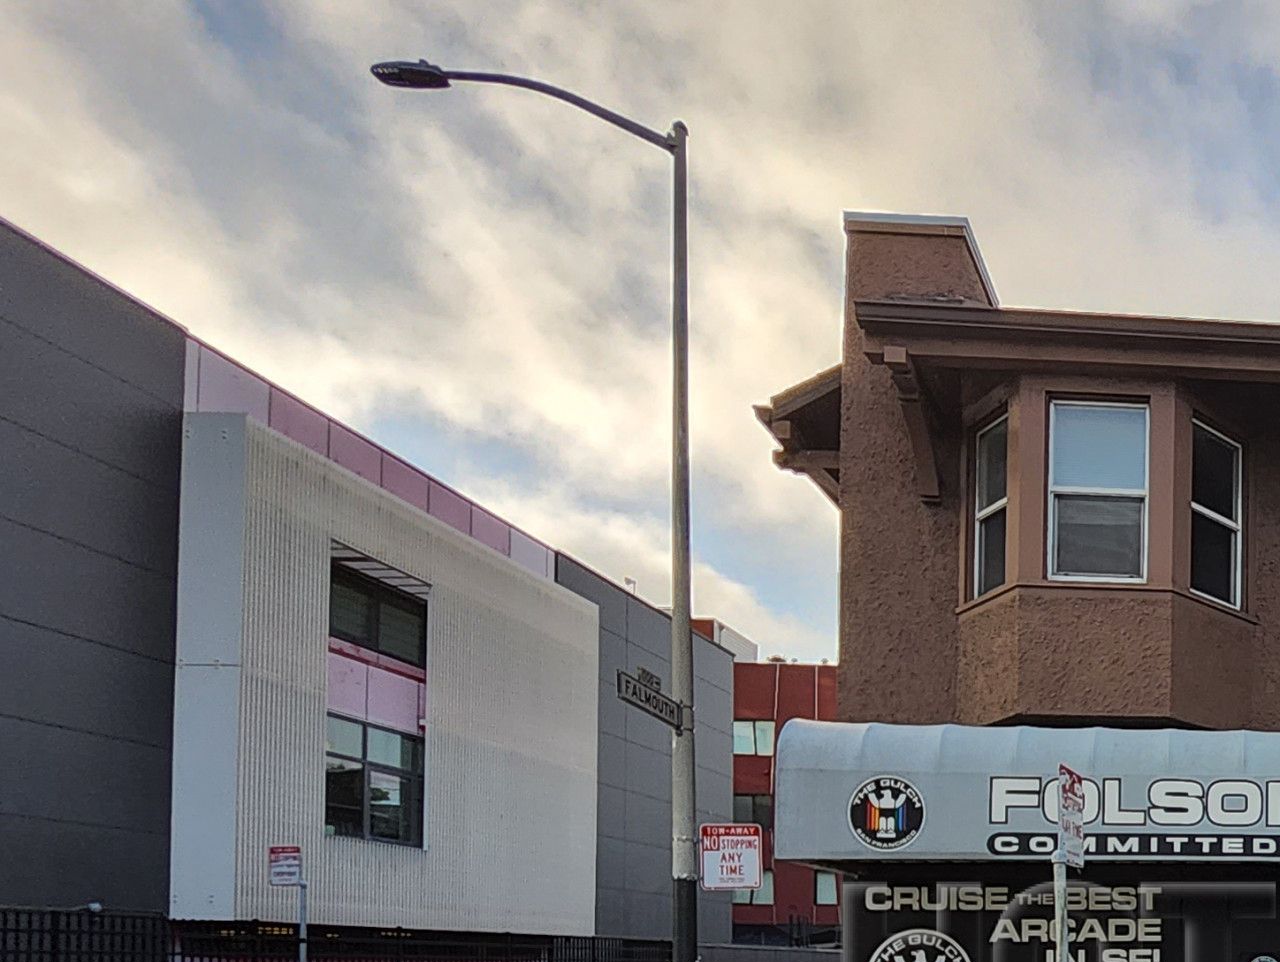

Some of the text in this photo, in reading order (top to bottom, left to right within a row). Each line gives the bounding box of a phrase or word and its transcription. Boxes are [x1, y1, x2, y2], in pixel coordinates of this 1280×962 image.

[625, 679, 675, 720] FALMOUTH
[853, 778, 922, 808] THE GULCH
[707, 827, 755, 835] TOW-AWAY
[856, 828, 872, 844] SAN
[703, 836, 758, 850] NO STOPPING
[993, 836, 1278, 854] COMITTED
[720, 852, 743, 863] ANY
[719, 865, 745, 876] TIME
[865, 886, 1162, 911] CRUISE THE BEST
[989, 918, 1162, 942] ARCADE
